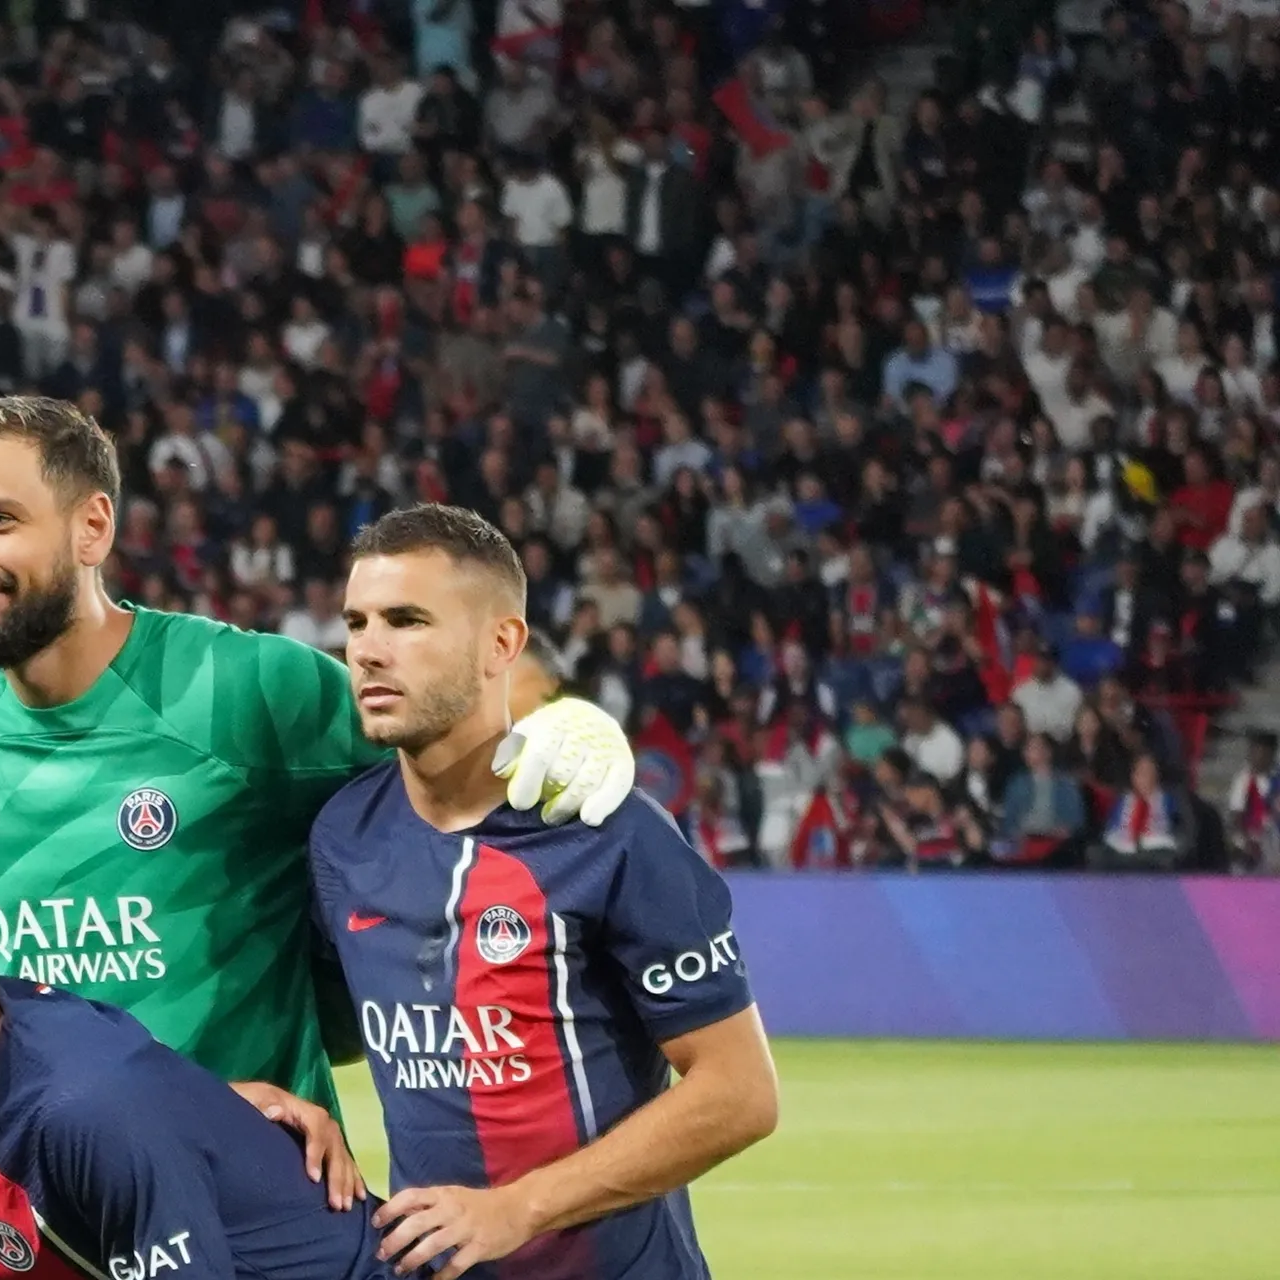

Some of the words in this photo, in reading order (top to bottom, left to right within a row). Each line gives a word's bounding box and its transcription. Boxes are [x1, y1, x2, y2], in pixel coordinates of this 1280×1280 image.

[126, 792, 164, 808] PARIS
[483, 908, 519, 924] PARIS
[18, 947, 165, 985] AIRWAYS
[642, 931, 738, 995] GOAT
[360, 1000, 526, 1064] QATAR
[394, 1054, 532, 1090] AIRWAYS
